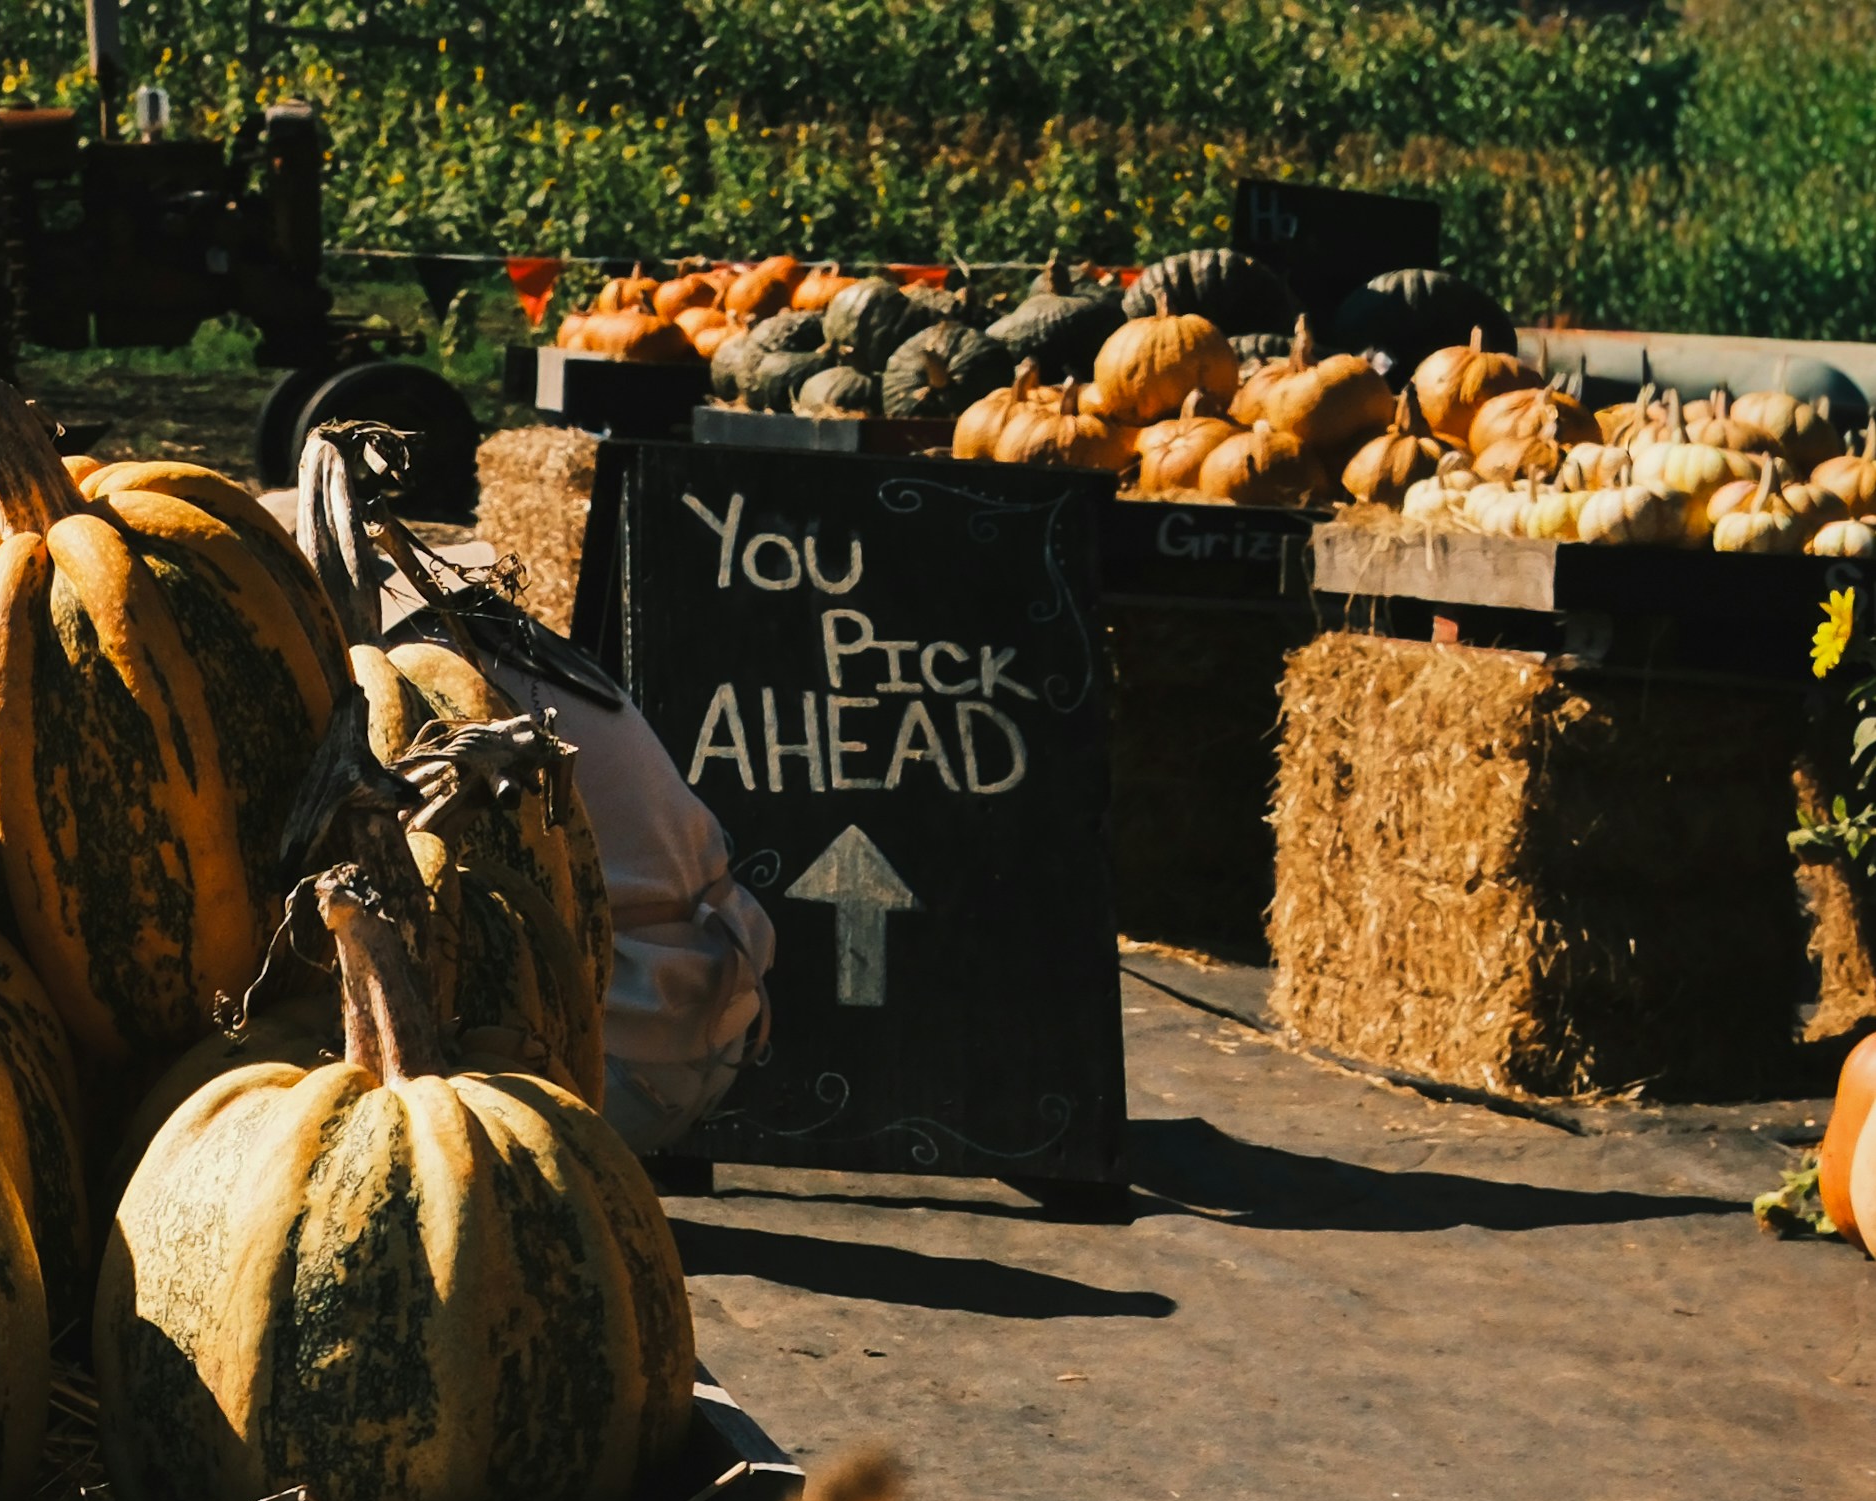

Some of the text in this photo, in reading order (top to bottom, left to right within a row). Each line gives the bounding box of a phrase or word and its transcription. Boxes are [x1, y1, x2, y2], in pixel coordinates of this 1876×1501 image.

[1156, 512, 1279, 560] Griz
[822, 609, 1039, 699] PICK
[687, 683, 1028, 794] AHEAD
